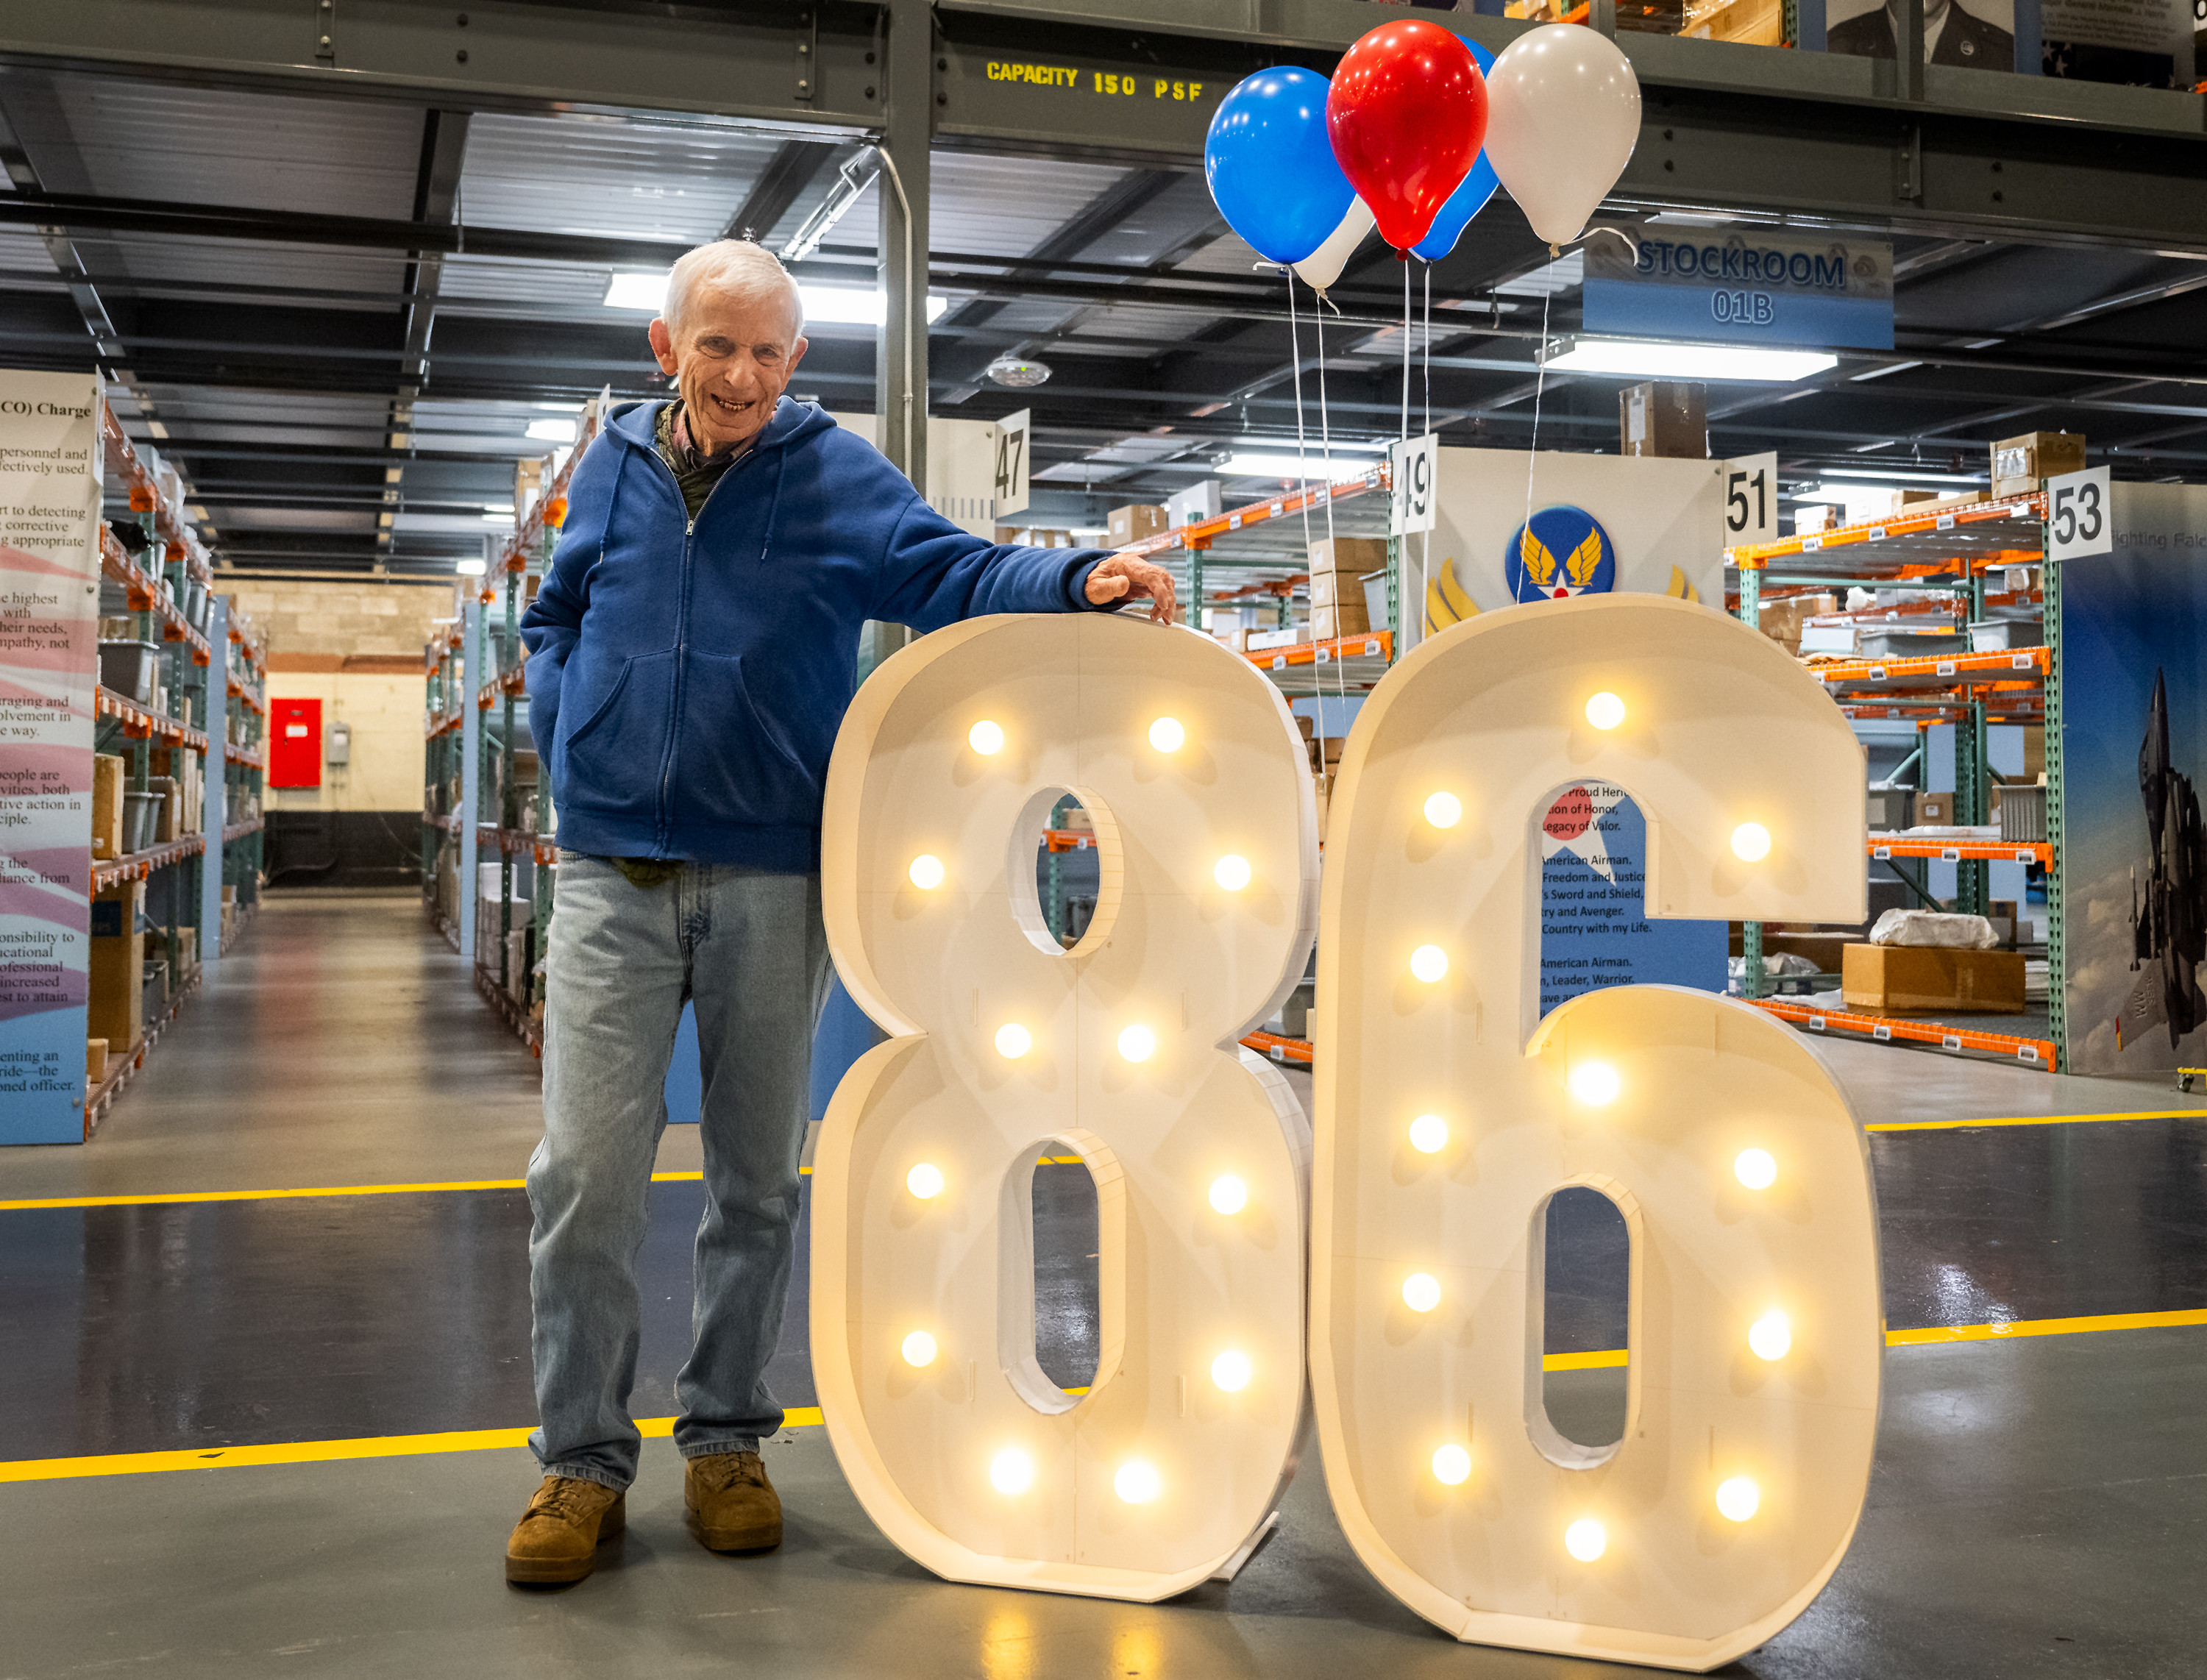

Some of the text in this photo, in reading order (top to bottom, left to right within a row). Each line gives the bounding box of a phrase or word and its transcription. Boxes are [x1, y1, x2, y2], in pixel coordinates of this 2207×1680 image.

[987, 61, 1203, 102] CAPACITY 150 PSF
[1637, 240, 1847, 287] STOCKROOM
[1711, 288, 1774, 325] 01B
[37, 402, 91, 420] Charge
[0, 447, 88, 460] personnel and
[0, 460, 89, 476] ectively used.
[995, 428, 1024, 499] 47
[1396, 451, 1431, 518] 49
[1726, 469, 1766, 533] 51
[13, 507, 24, 515] to
[28, 505, 86, 521] detecting
[2054, 483, 2102, 544] 53
[5, 521, 69, 532] corrective
[13, 535, 85, 549] appropriate
[13, 592, 58, 607] highest
[3, 607, 31, 618] with
[50, 639, 70, 649] not
[46, 695, 69, 707] and
[60, 710, 71, 722] in
[12, 727, 40, 739] way.
[0, 769, 60, 783] eople are
[42, 784, 71, 795] both
[1602, 787, 1628, 797] Heri
[26, 798, 65, 810] action
[69, 798, 81, 810] in
[1549, 803, 1618, 816] ion of Honor,
[1579, 821, 1590, 831] of
[1592, 821, 1621, 831] Valor.
[9, 857, 28, 869] the
[1591, 855, 1632, 866] Airman.
[40, 871, 70, 883] from
[1543, 872, 1588, 883] Freedom
[1591, 872, 1611, 882] and
[1551, 889, 1584, 900] Sword
[1587, 889, 1606, 899] and
[1609, 888, 1643, 900] Shield,
[1557, 906, 1577, 916] and
[1579, 906, 1624, 918] Avenger.
[1542, 922, 1652, 936] Country with my Life.
[63, 933, 75, 942] to
[1540, 957, 1632, 969] American Airman.
[1552, 975, 1589, 986] Leader,
[1593, 973, 1635, 985] Warrior.
[17, 993, 29, 1002] to
[33, 990, 68, 1002] attain
[43, 1053, 60, 1061] an
[30, 1079, 76, 1092] officer.
